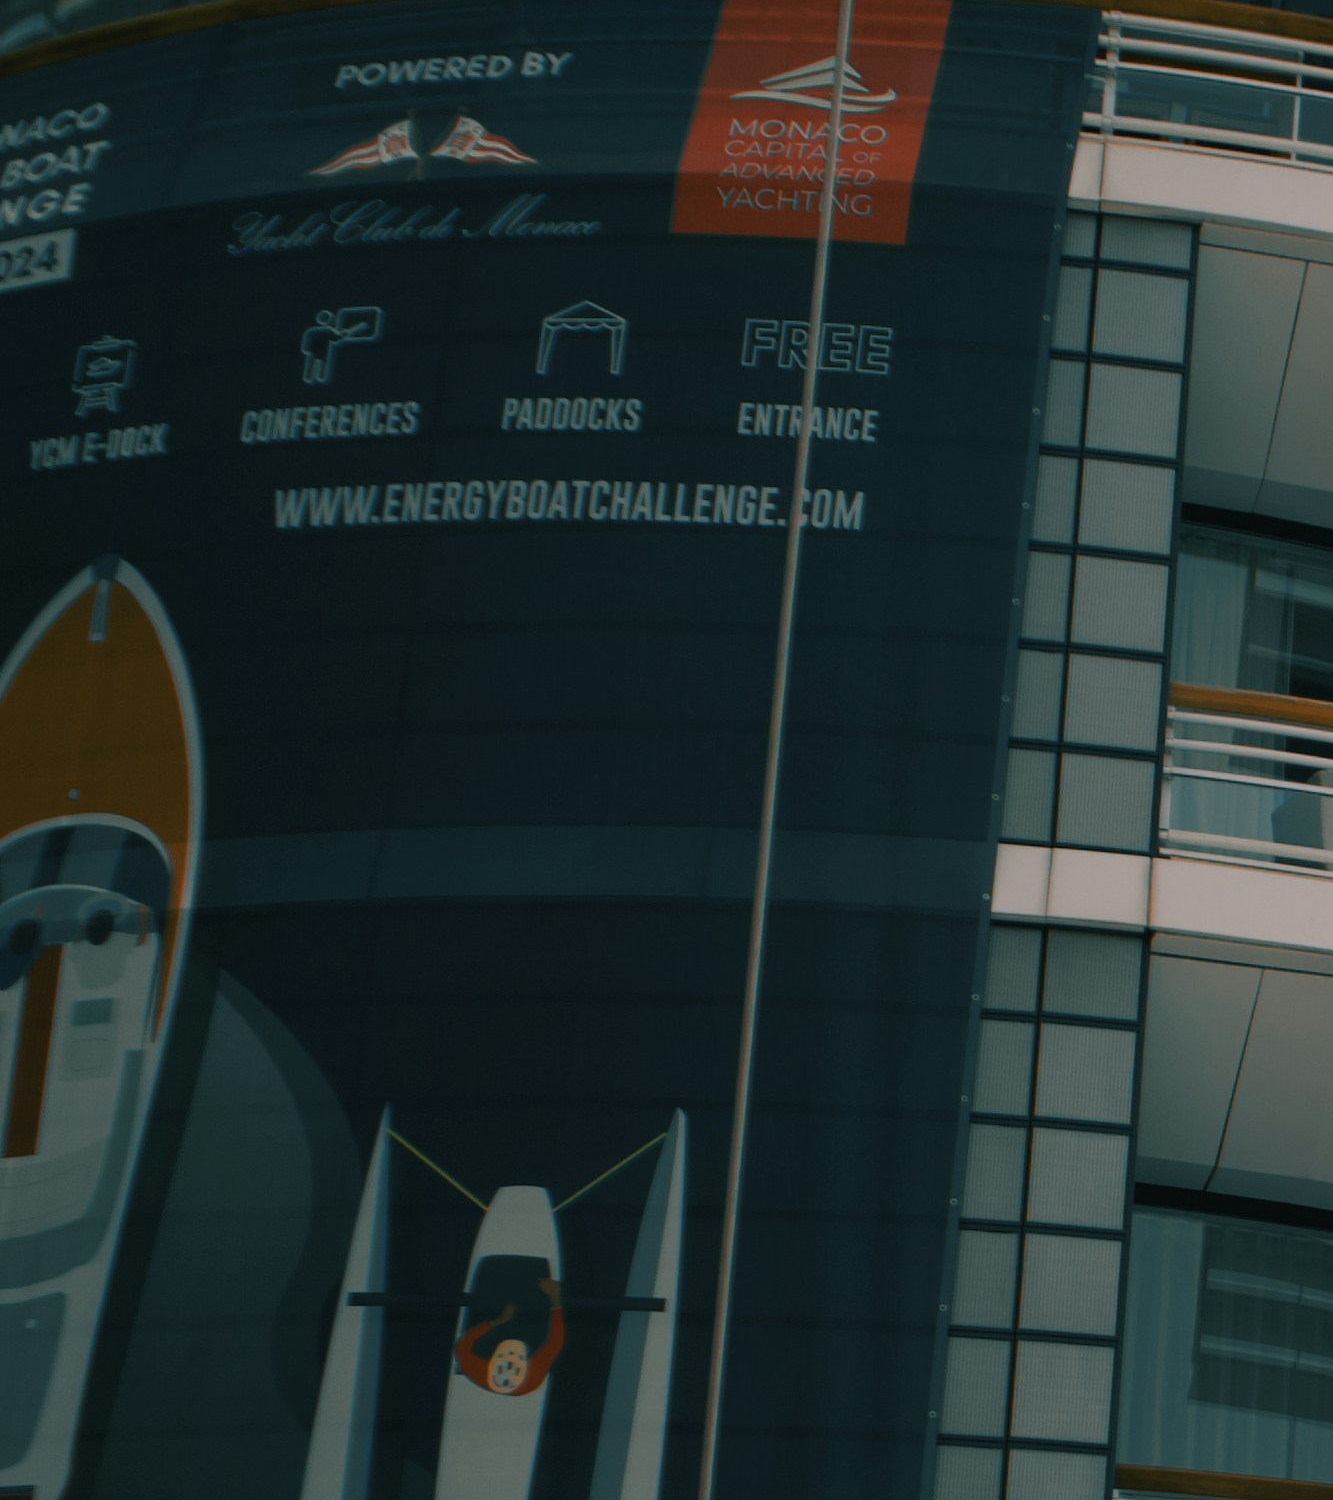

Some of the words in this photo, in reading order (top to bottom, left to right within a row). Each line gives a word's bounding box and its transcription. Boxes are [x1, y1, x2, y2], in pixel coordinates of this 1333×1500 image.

[334, 55, 515, 89] POWERED
[520, 51, 576, 78] BY
[729, 117, 888, 146] MONACO
[0, 140, 114, 192] BOAT
[719, 161, 878, 188] ADVANCED
[852, 151, 883, 165] OF
[717, 186, 874, 217] YACHTING
[226, 212, 330, 257] Yacht
[329, 198, 434, 246] Club
[418, 206, 463, 242] de
[462, 193, 601, 238] Monaco
[741, 317, 894, 376] FREE
[239, 401, 422, 445] CONFERENCES
[501, 396, 644, 433] PADDOCKS
[736, 401, 881, 443] ENTRANCE
[29, 435, 81, 471] YCM
[81, 423, 170, 464] E-DOCK
